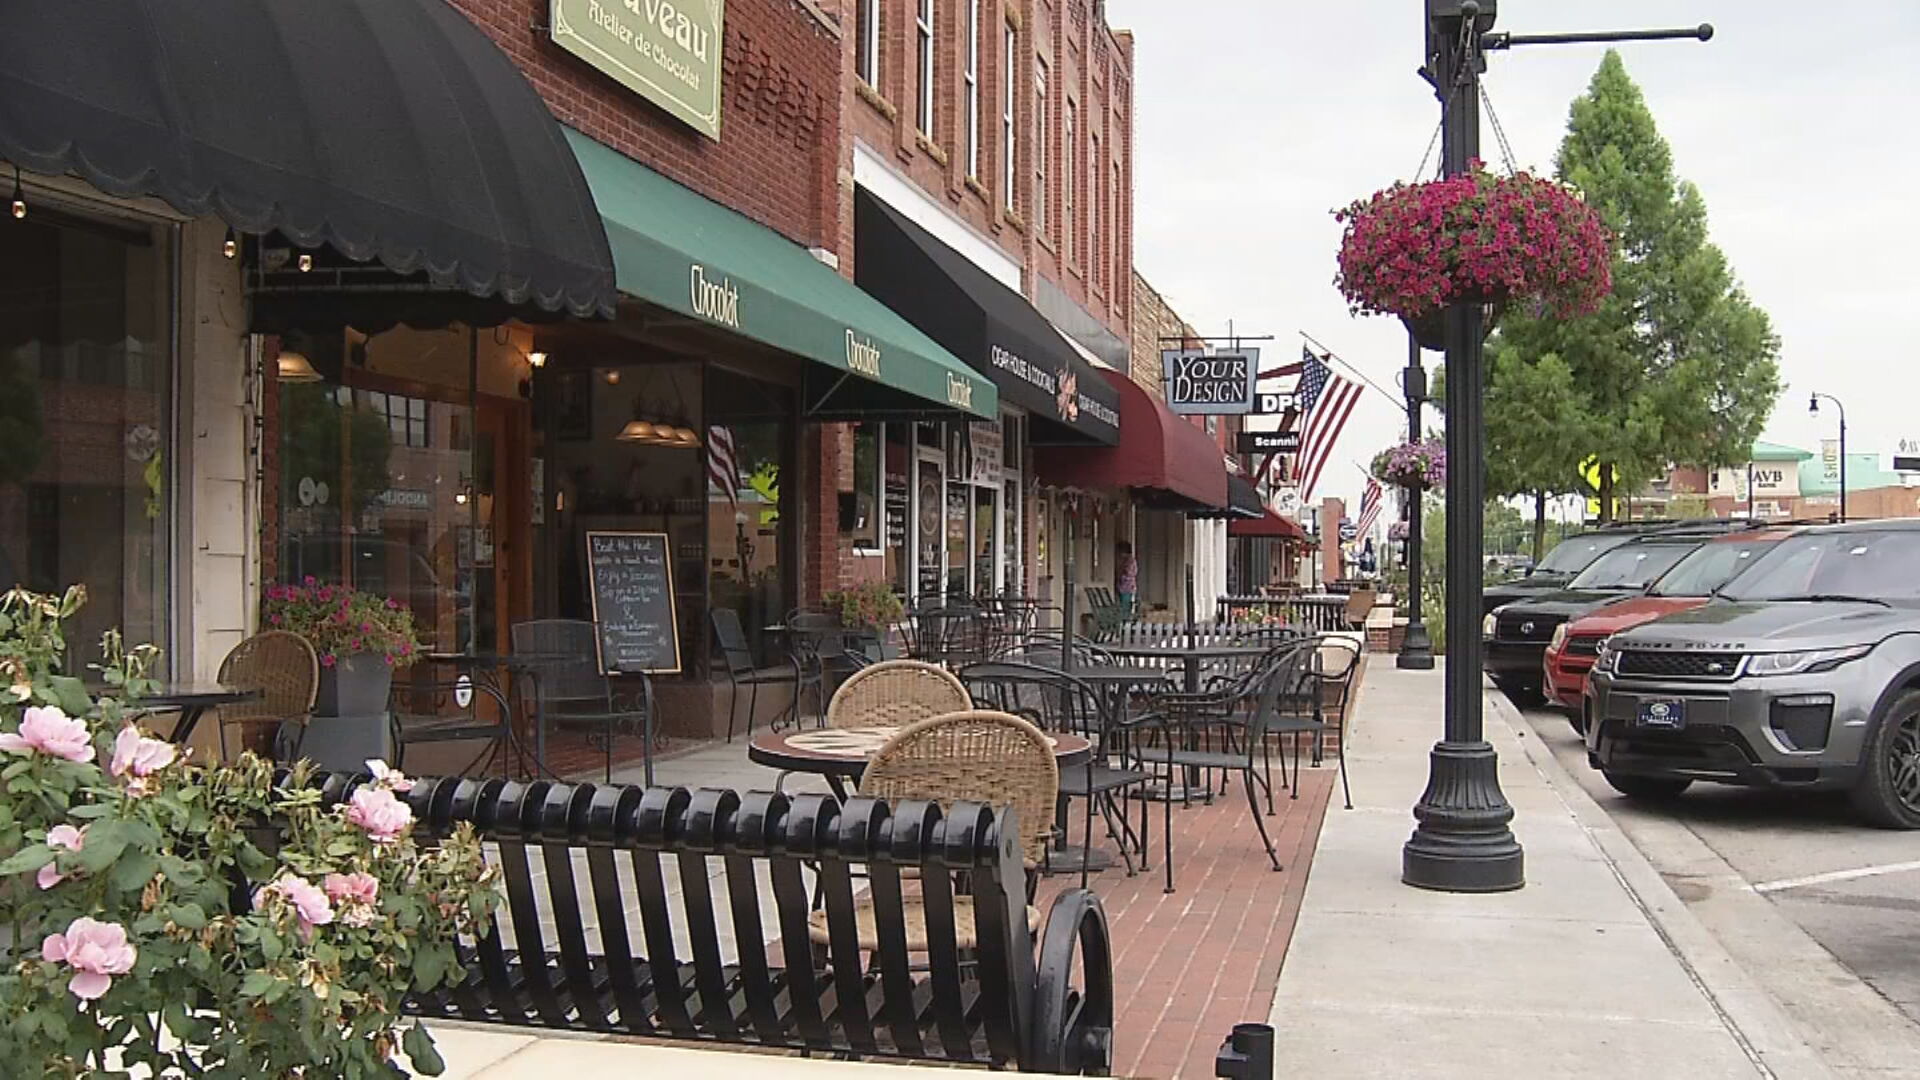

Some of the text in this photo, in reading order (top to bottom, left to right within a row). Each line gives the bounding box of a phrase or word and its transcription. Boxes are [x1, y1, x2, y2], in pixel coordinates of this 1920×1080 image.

[588, 0, 701, 90] Atelier de Chocolat
[690, 264, 739, 328] Chocolat
[845, 329, 881, 378] Chocolat
[1177, 356, 1247, 379] YOUR
[1174, 376, 1245, 403] DESIGN
[1752, 470, 1783, 482] AVB
